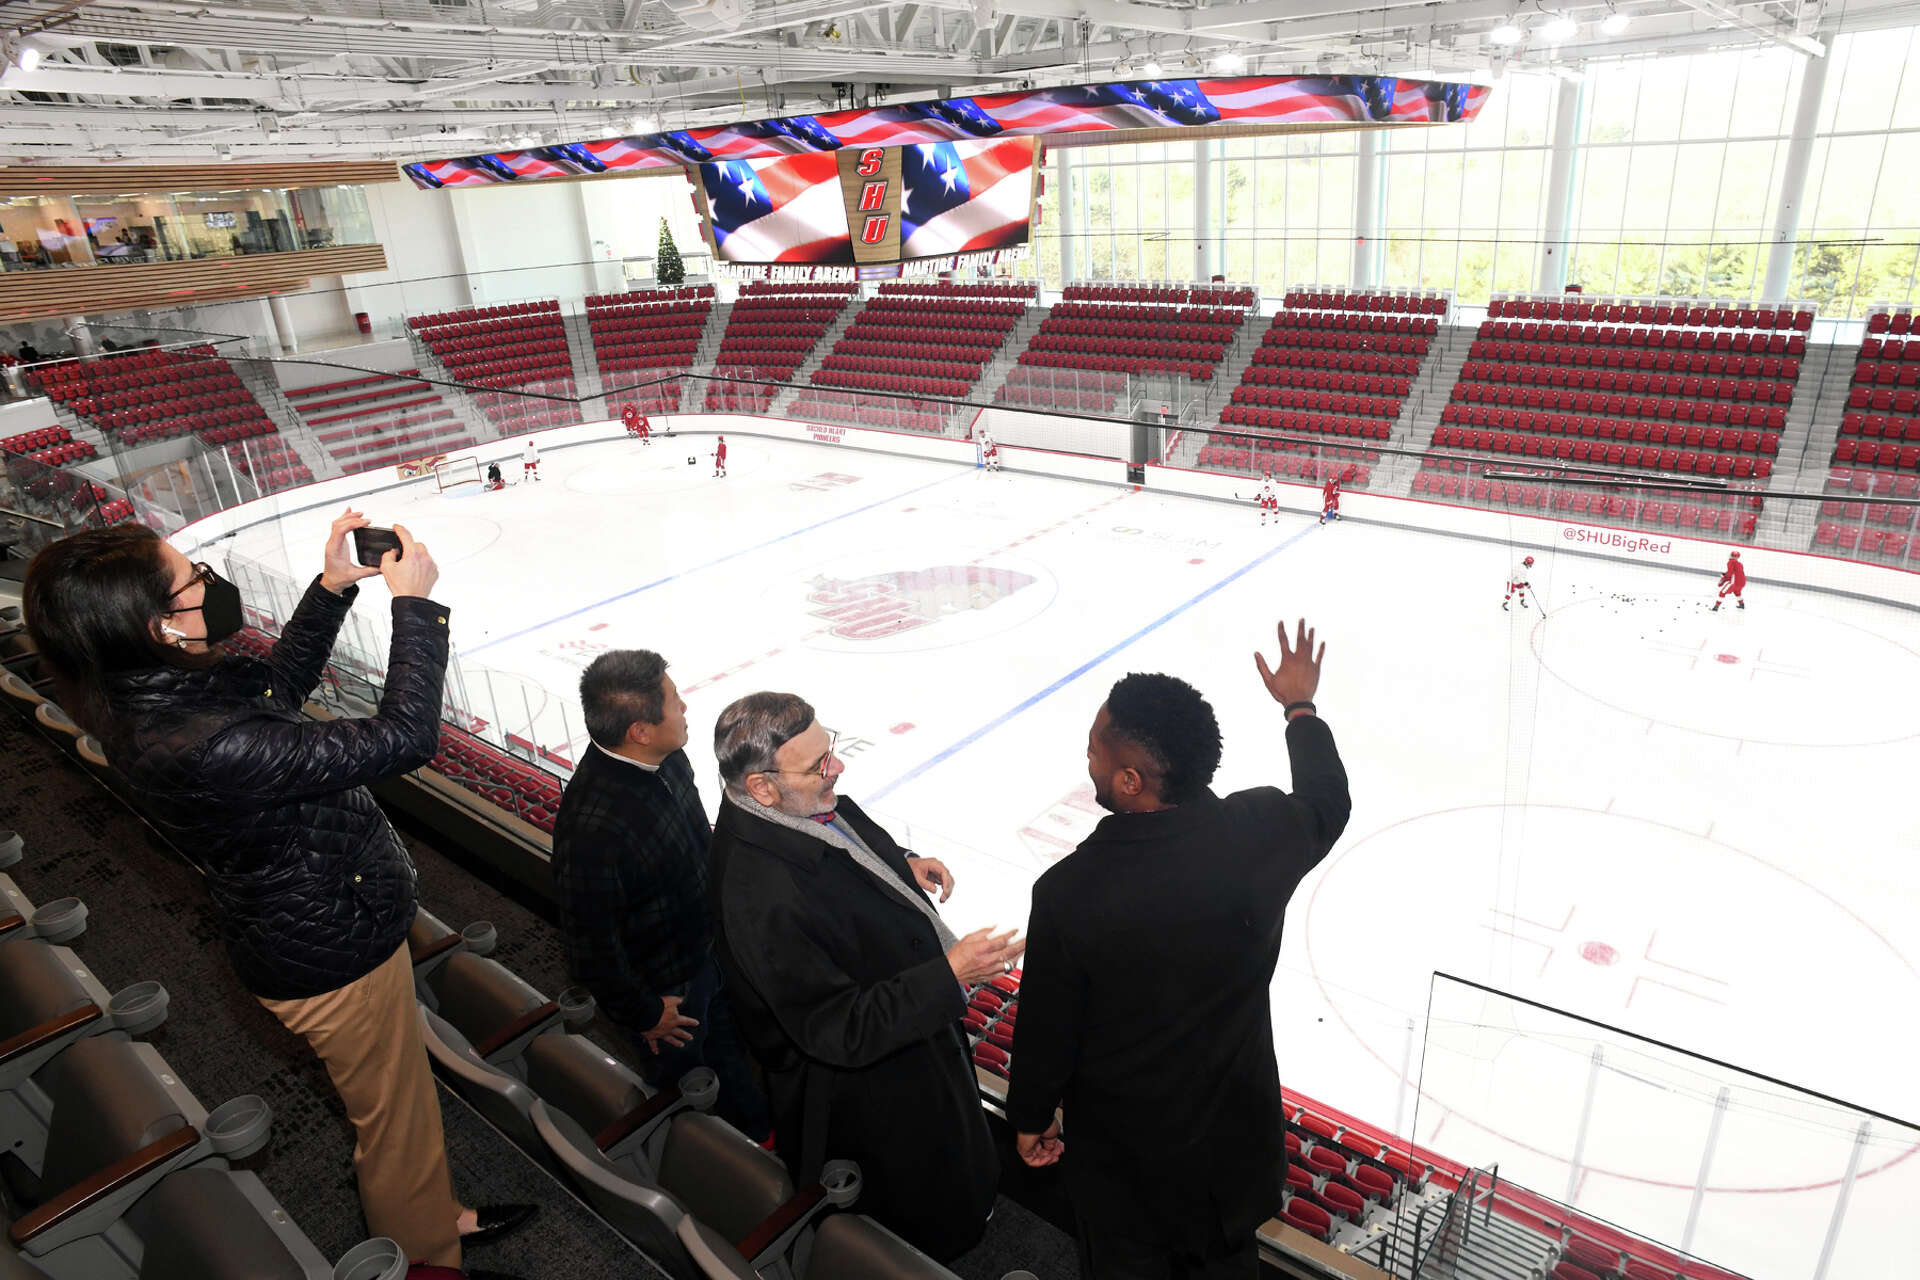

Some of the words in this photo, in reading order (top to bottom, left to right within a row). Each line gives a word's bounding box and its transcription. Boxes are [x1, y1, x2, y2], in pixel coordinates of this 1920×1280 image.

[856, 147, 890, 245] SHU
[769, 265, 813, 281] FAMILY
[813, 266, 856, 281] ARENA
[902, 256, 955, 278] MARTIRE
[957, 251, 998, 270] FAMILY
[998, 246, 1031, 263] ARENA
[1563, 527, 1672, 554] @SHUBigRed
